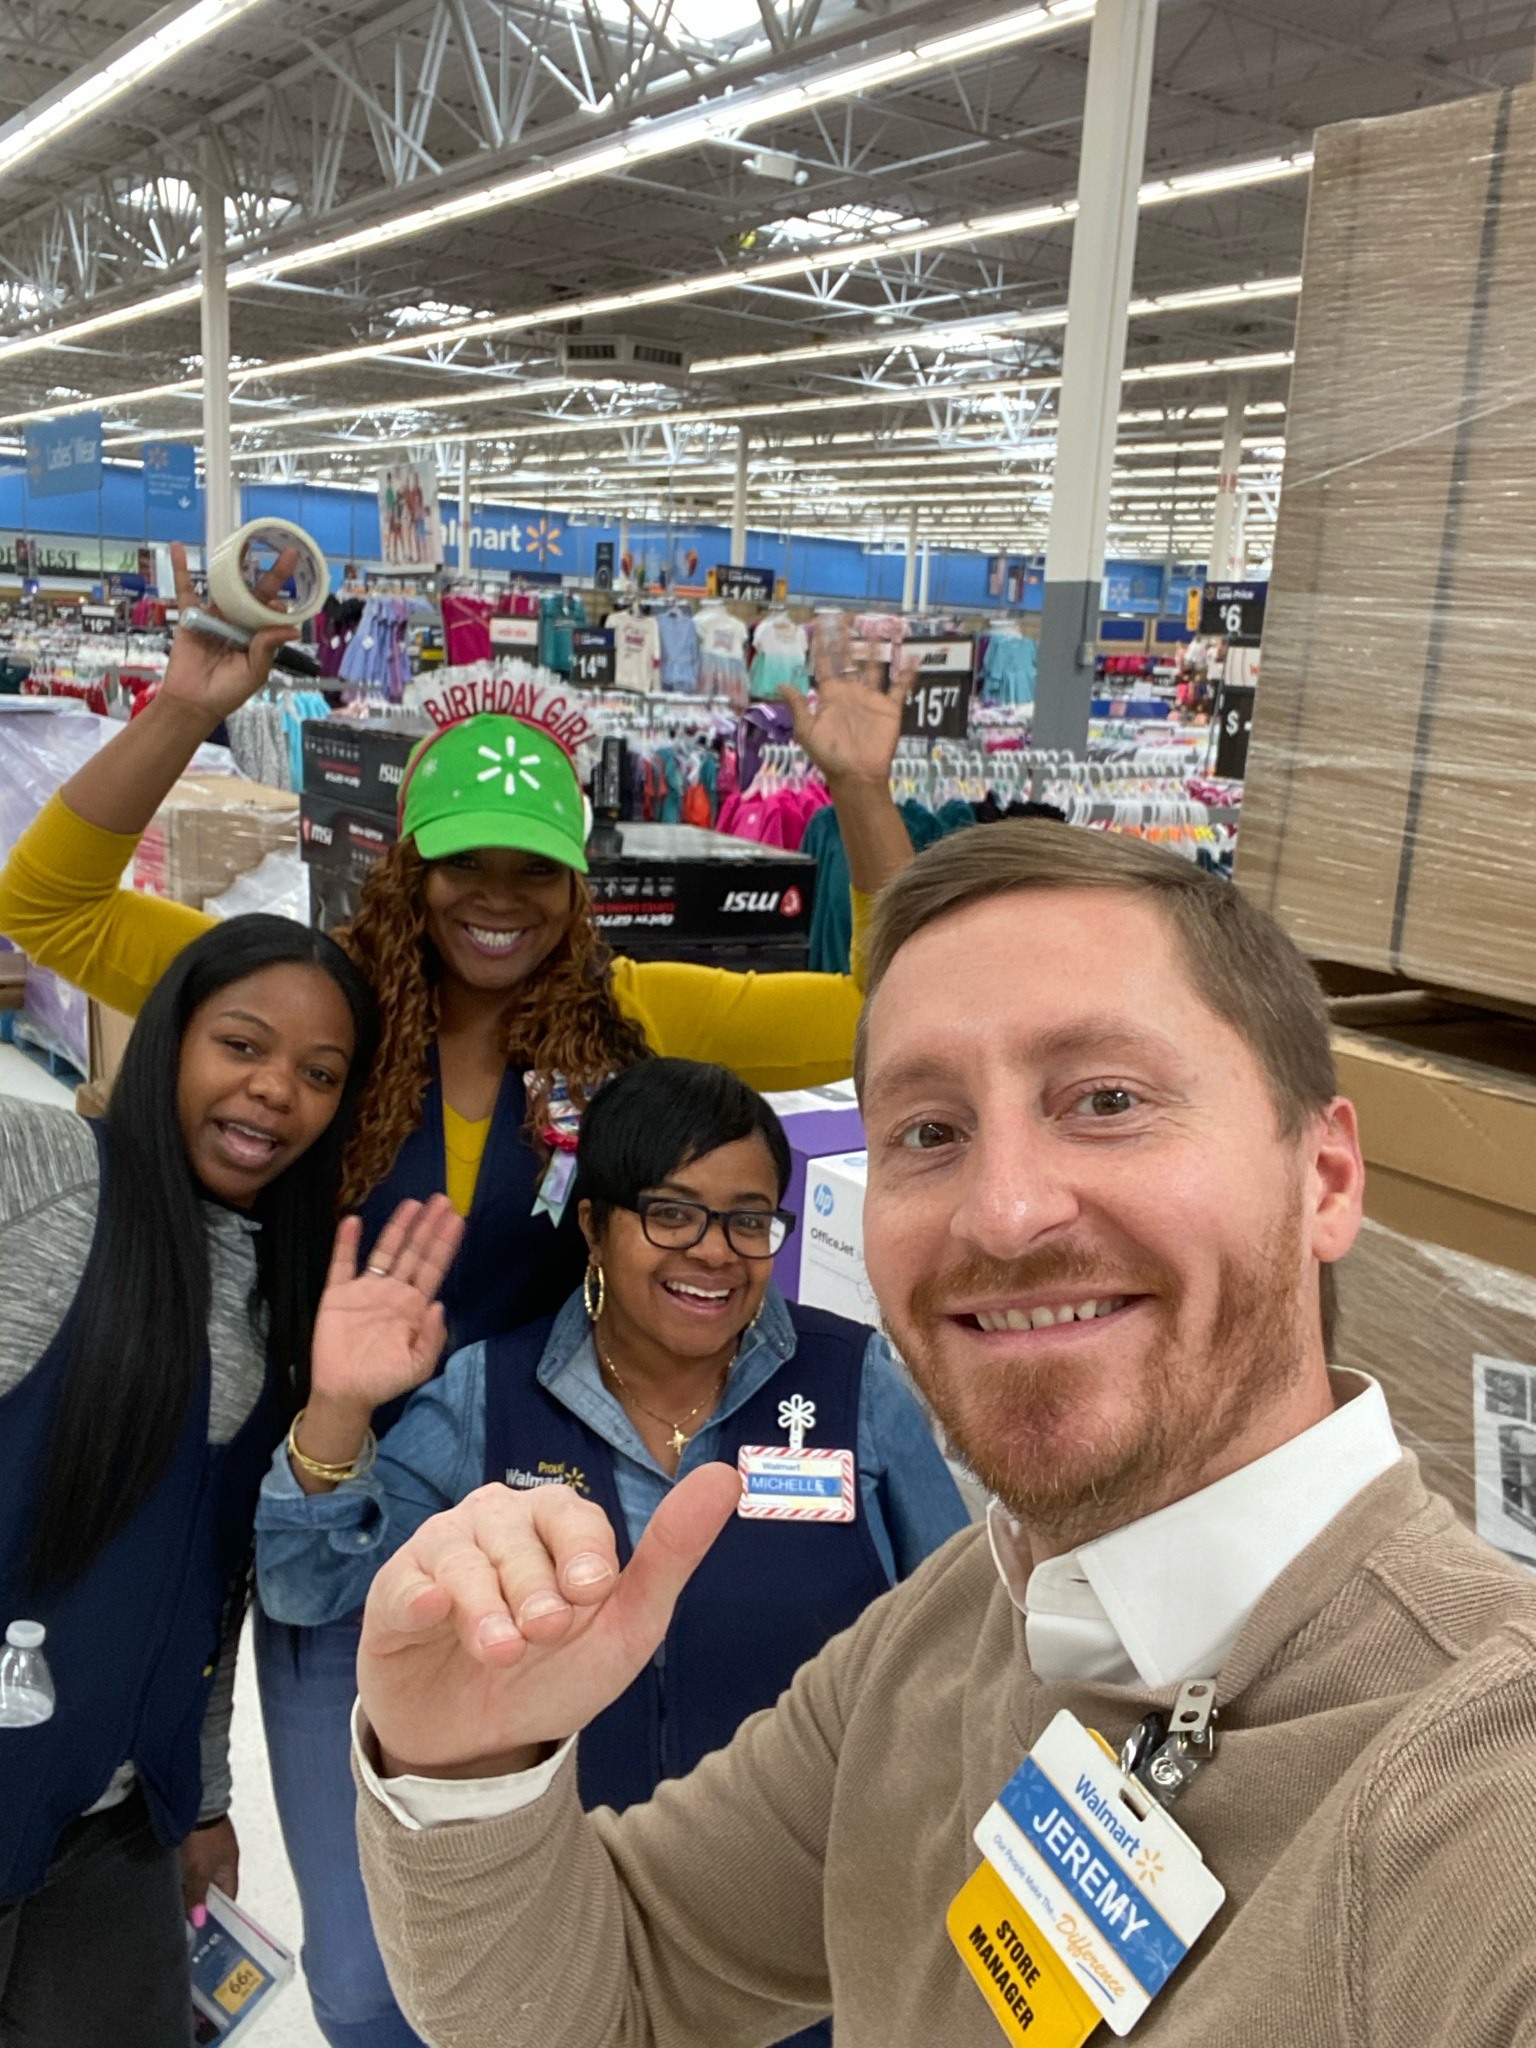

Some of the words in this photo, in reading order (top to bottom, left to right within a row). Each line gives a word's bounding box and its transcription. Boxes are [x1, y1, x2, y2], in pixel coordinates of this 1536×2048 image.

[1219, 604, 1241, 632] $6
[424, 680, 545, 729] BIRTHDAY
[542, 696, 596, 756] GIRL
[724, 891, 780, 913] msi
[814, 1183, 834, 1217] hp
[810, 1227, 854, 1257] OfficeJet
[762, 1462, 801, 1472] Walmart
[1074, 1773, 1140, 1858] Walmart
[1032, 1807, 1149, 1943] JEREMY
[968, 1925, 1035, 2032] MANAGER
[995, 1919, 1041, 1990] STORE
[1055, 1912, 1125, 1998] Difference
